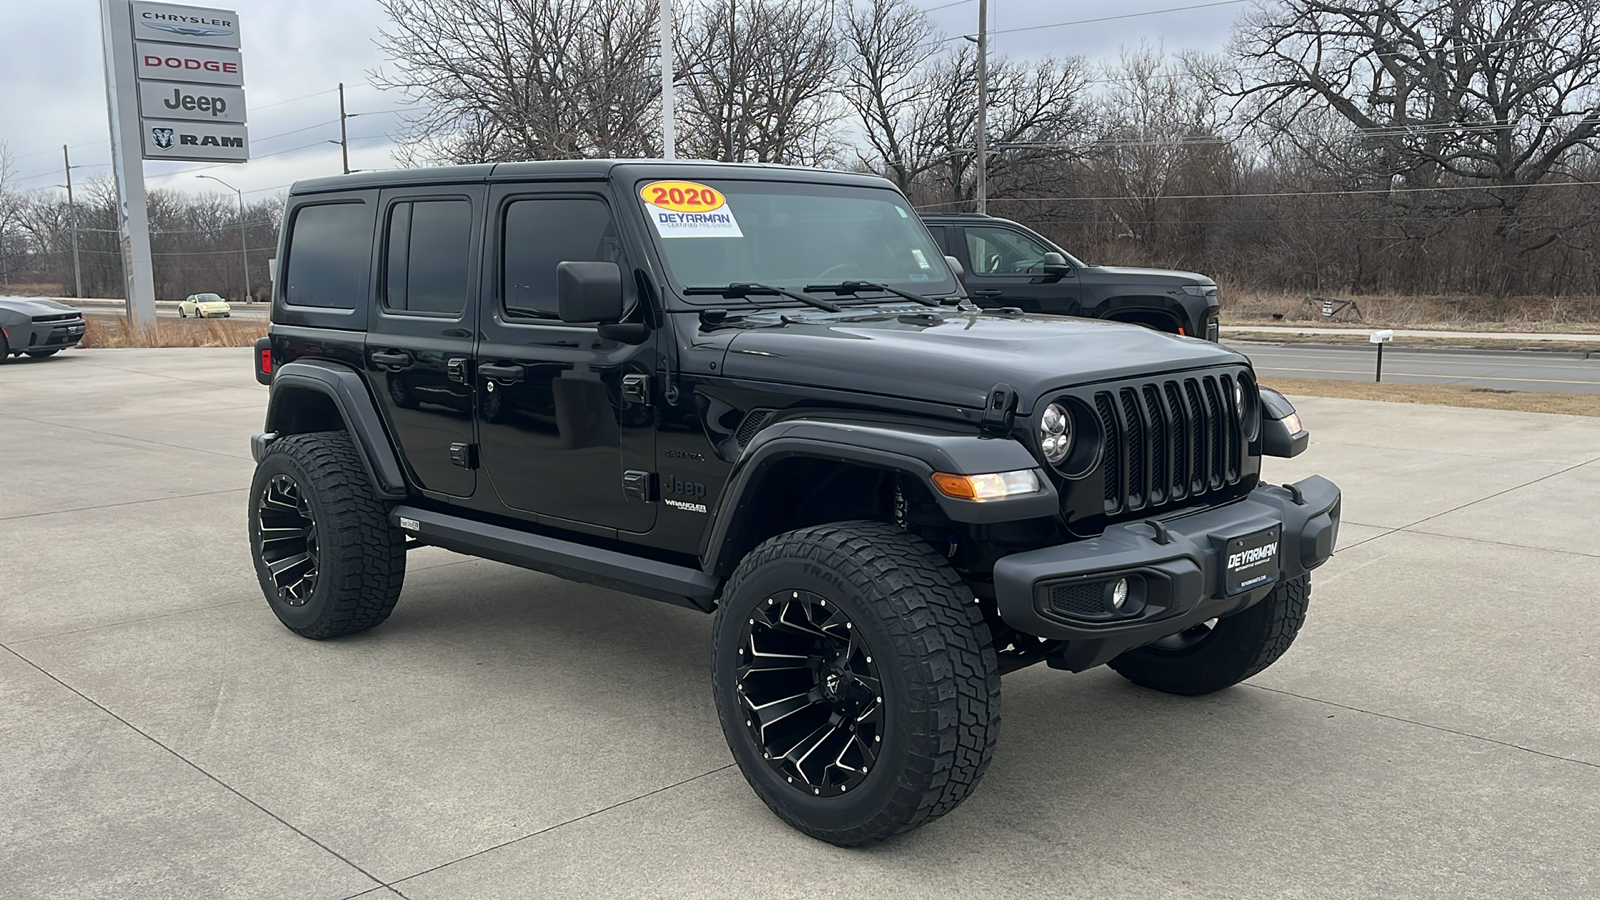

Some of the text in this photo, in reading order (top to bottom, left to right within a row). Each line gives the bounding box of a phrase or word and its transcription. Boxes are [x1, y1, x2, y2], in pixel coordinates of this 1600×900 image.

[142, 12, 231, 27] CHRYSLER
[144, 55, 237, 73] DODGE
[164, 88, 226, 116] Jeep
[179, 134, 243, 148] RAM
[652, 187, 716, 206] 2020
[659, 213, 730, 223] DEYARMAN
[664, 475, 706, 500] Jeep
[665, 499, 706, 510] WRANGLER
[1227, 542, 1278, 569] DEYARMAN
[802, 562, 846, 593] TRAIL
